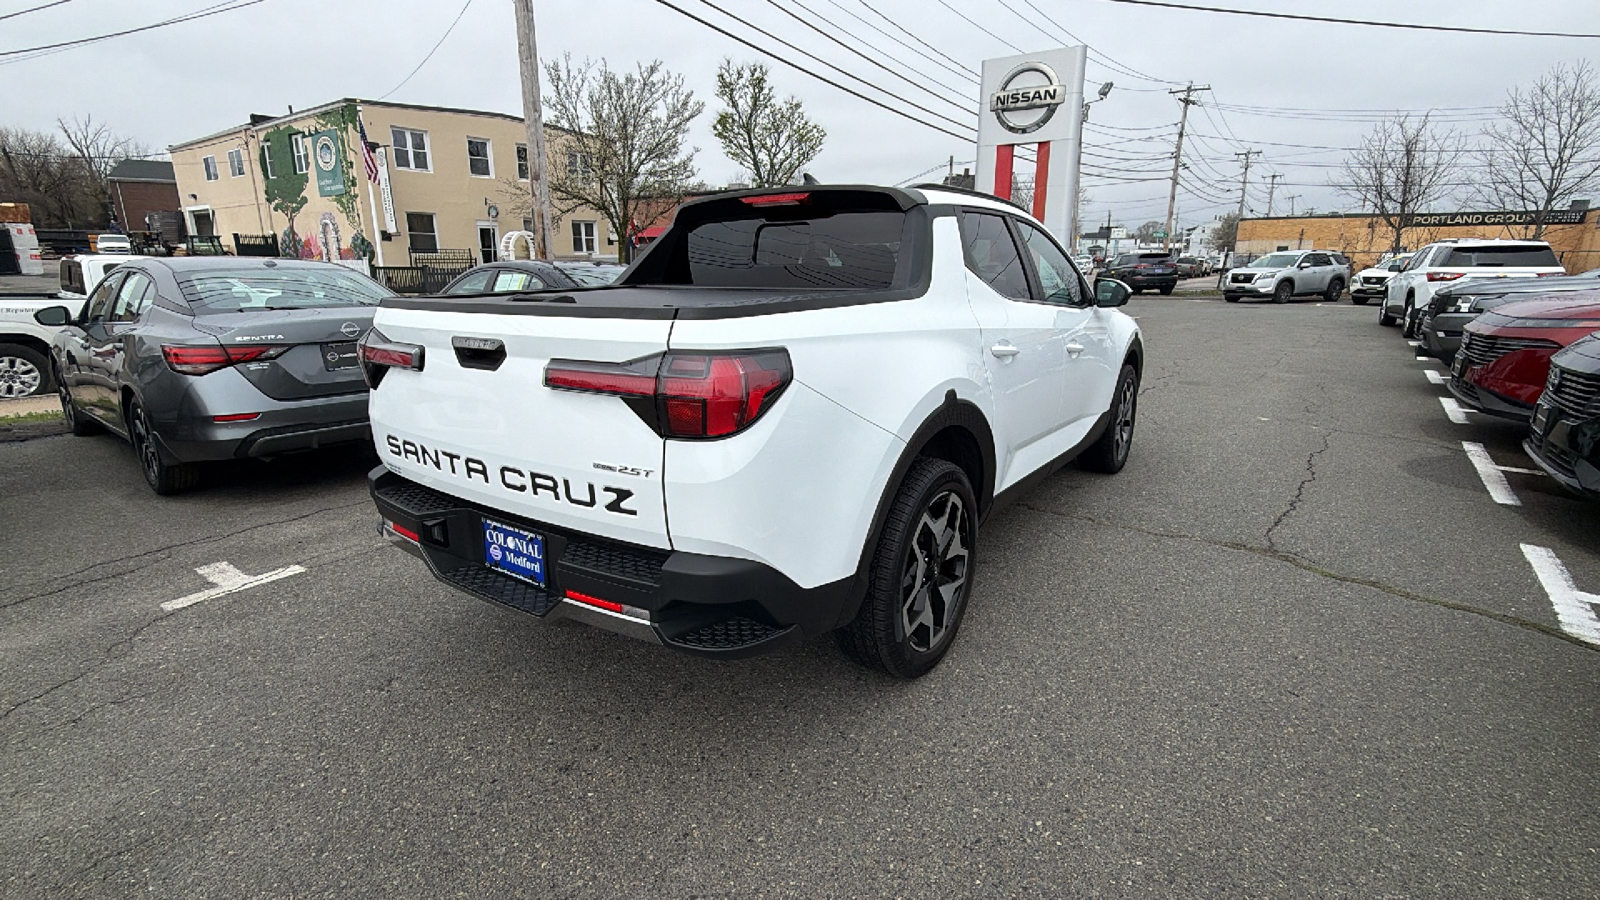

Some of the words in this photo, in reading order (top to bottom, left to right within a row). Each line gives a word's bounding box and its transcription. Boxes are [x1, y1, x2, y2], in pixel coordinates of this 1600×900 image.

[995, 88, 1057, 106] NISSAN
[1413, 215, 1482, 224] PORTLAND
[1484, 214, 1535, 223] GROUP
[234, 334, 285, 343] SENTRA
[386, 433, 490, 485] SANTA
[498, 465, 638, 516] CRUZ
[486, 529, 543, 560] COLONIAL
[504, 550, 541, 574] Medford
